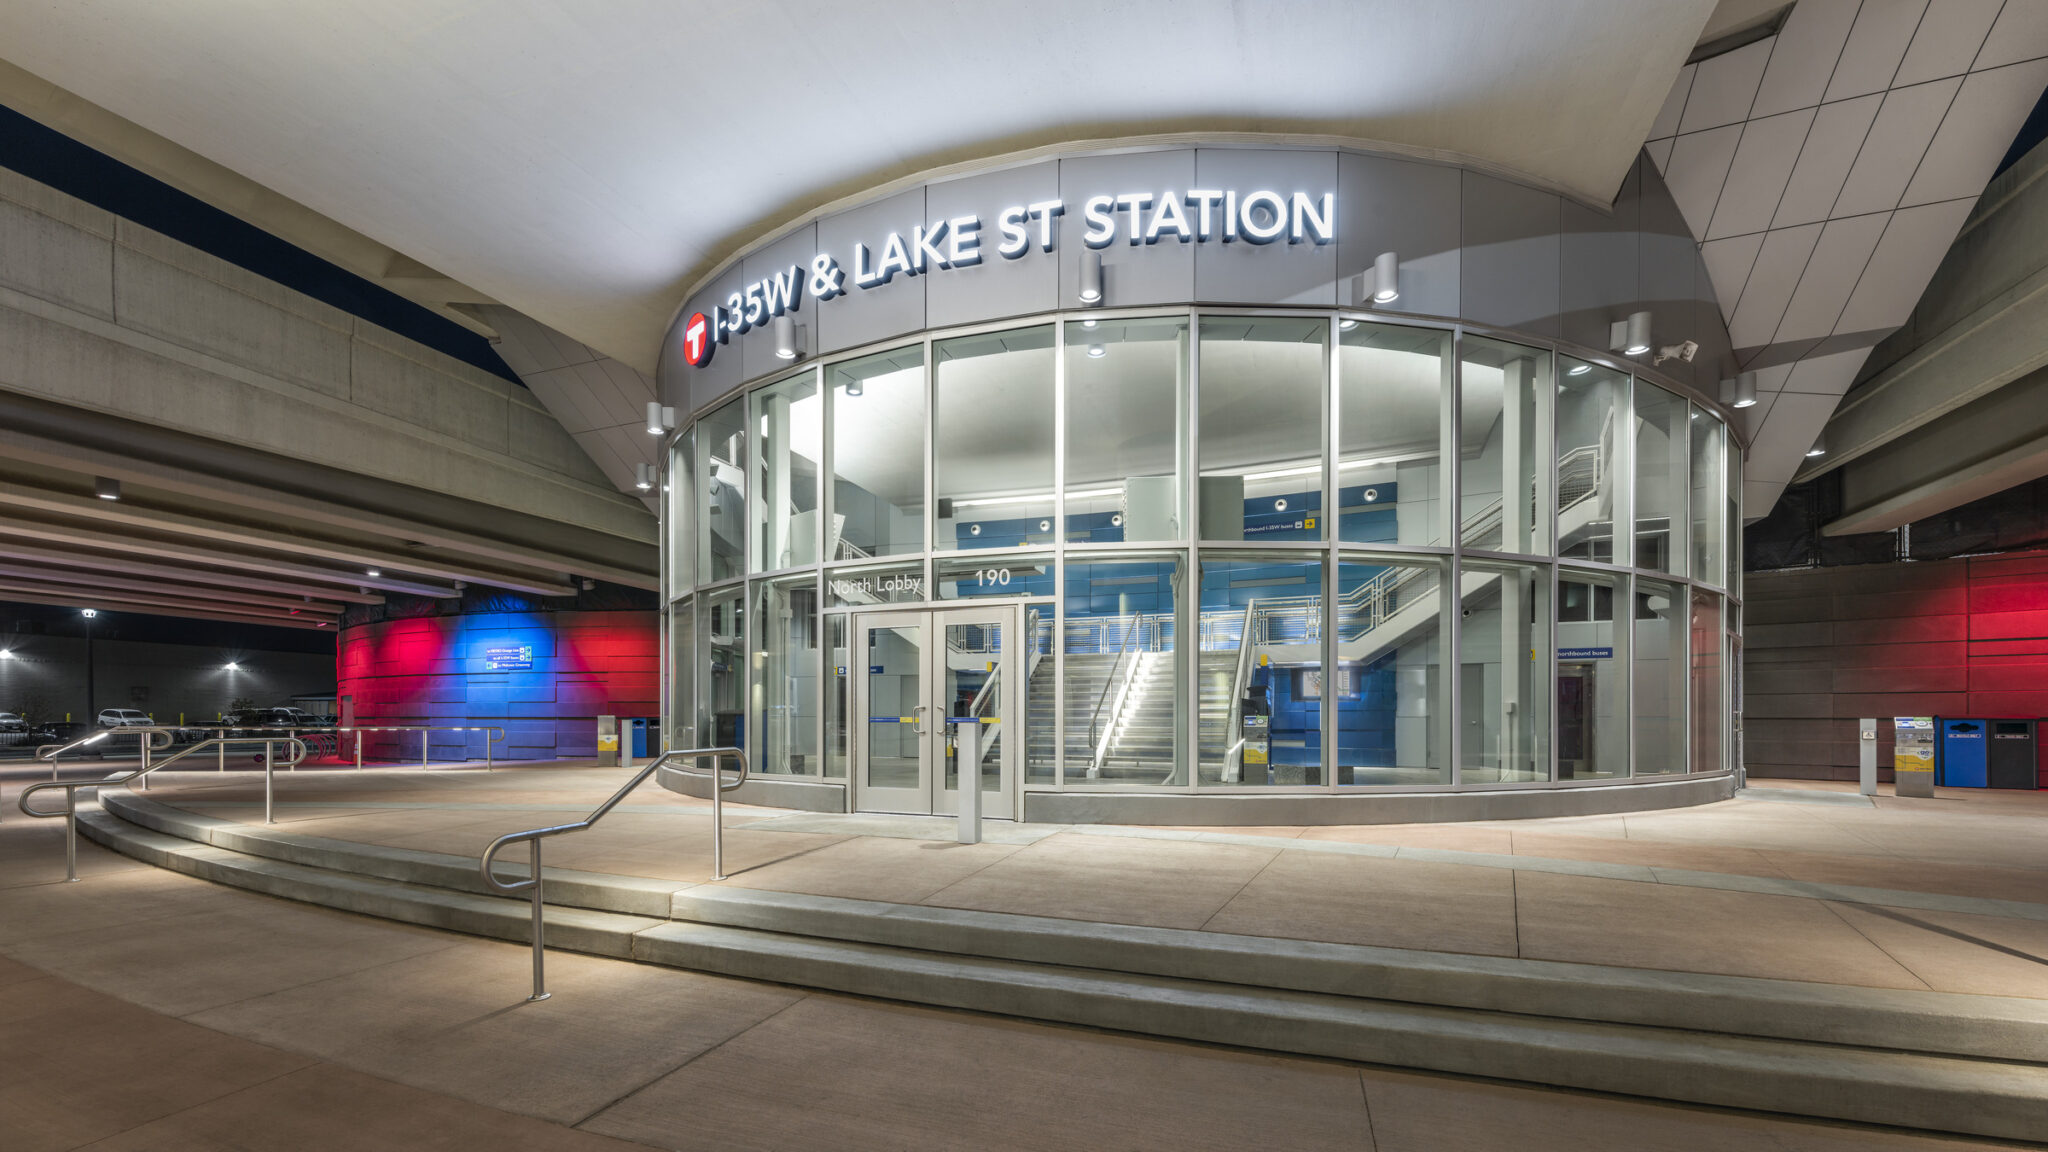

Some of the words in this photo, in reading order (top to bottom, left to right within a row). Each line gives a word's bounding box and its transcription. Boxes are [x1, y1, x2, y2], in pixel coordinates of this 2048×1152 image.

[713, 264, 801, 342] I-35W
[809, 253, 842, 298] &
[855, 214, 979, 286] LAKE
[998, 199, 1064, 256] ST
[1083, 190, 1334, 246] STATION
[828, 579, 872, 595] North
[877, 574, 921, 594] Lobby
[975, 568, 1011, 587] 190
